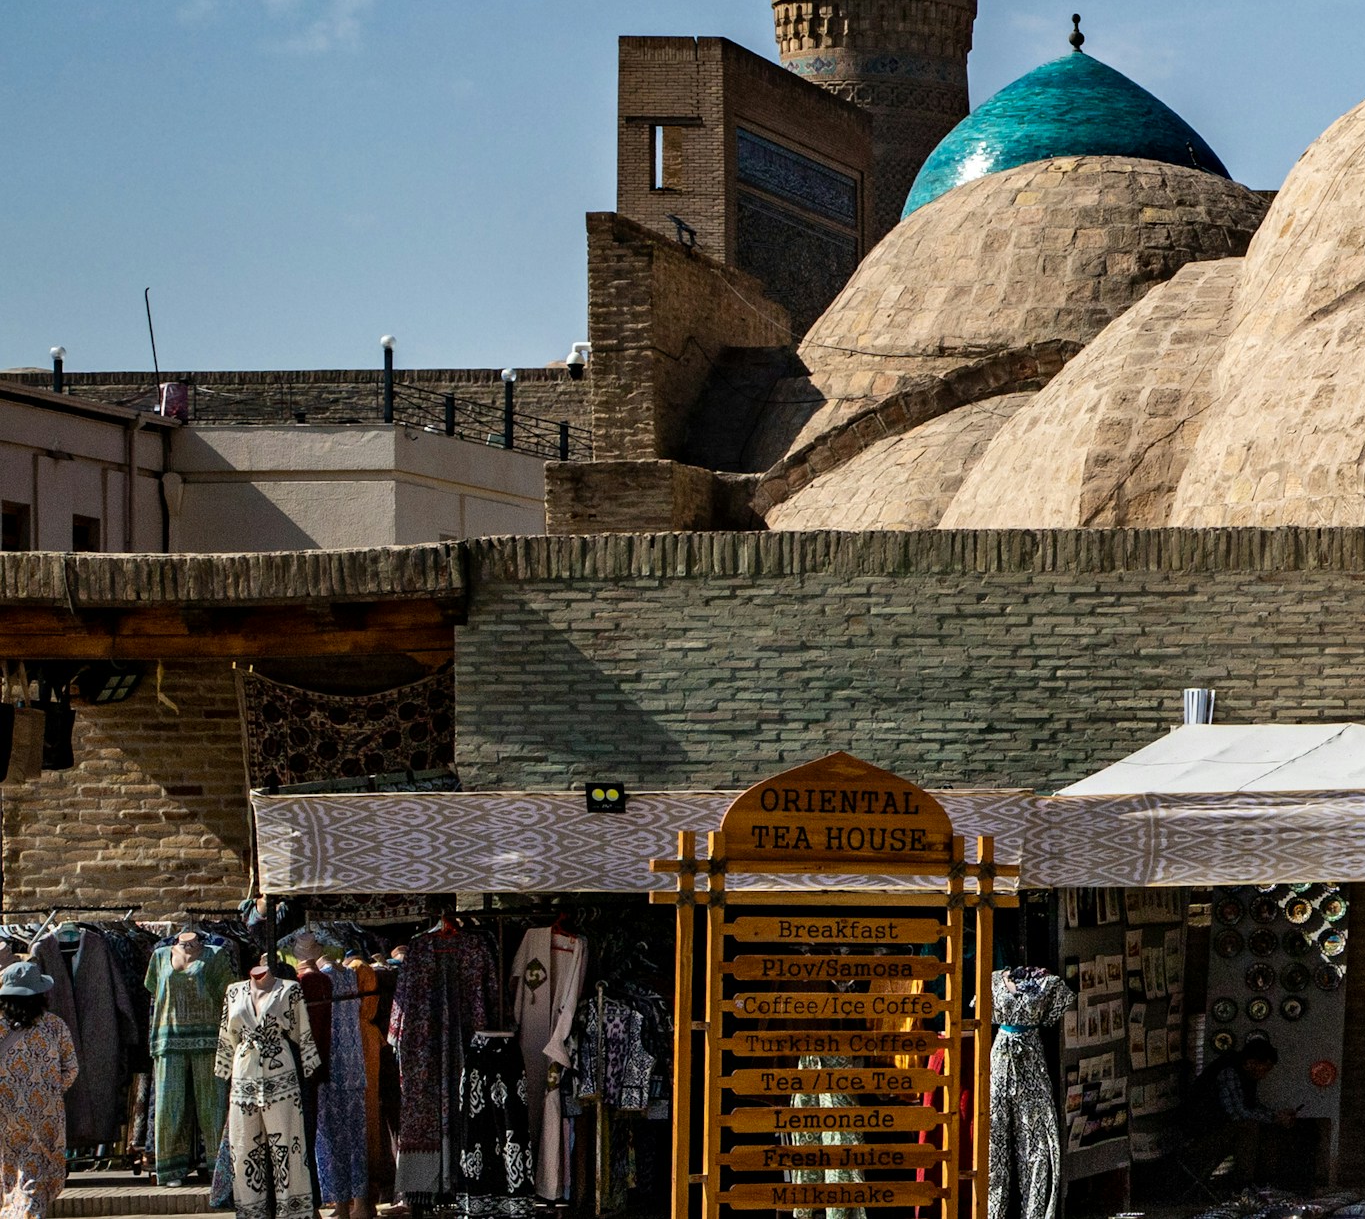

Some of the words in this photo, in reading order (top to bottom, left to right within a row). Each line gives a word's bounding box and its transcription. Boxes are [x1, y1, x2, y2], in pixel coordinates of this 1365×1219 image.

[761, 788, 920, 815] ORIENTAL
[752, 826, 814, 849] TEA
[825, 827, 927, 851] HOUSE
[778, 921, 898, 940] Breakfast
[762, 959, 913, 977] Plov/Samosa
[744, 996, 865, 1015] Coffee/Ice
[872, 997, 933, 1014] Coffe
[745, 1035, 838, 1053] Turkish
[849, 1035, 927, 1052] Coffee
[761, 1073, 803, 1091] Tea
[872, 1073, 914, 1090] Tea
[775, 1111, 894, 1129] Lemonade
[763, 1149, 830, 1168] Fresh
[840, 1148, 904, 1167] Juice
[772, 1186, 895, 1206] Milkshake
